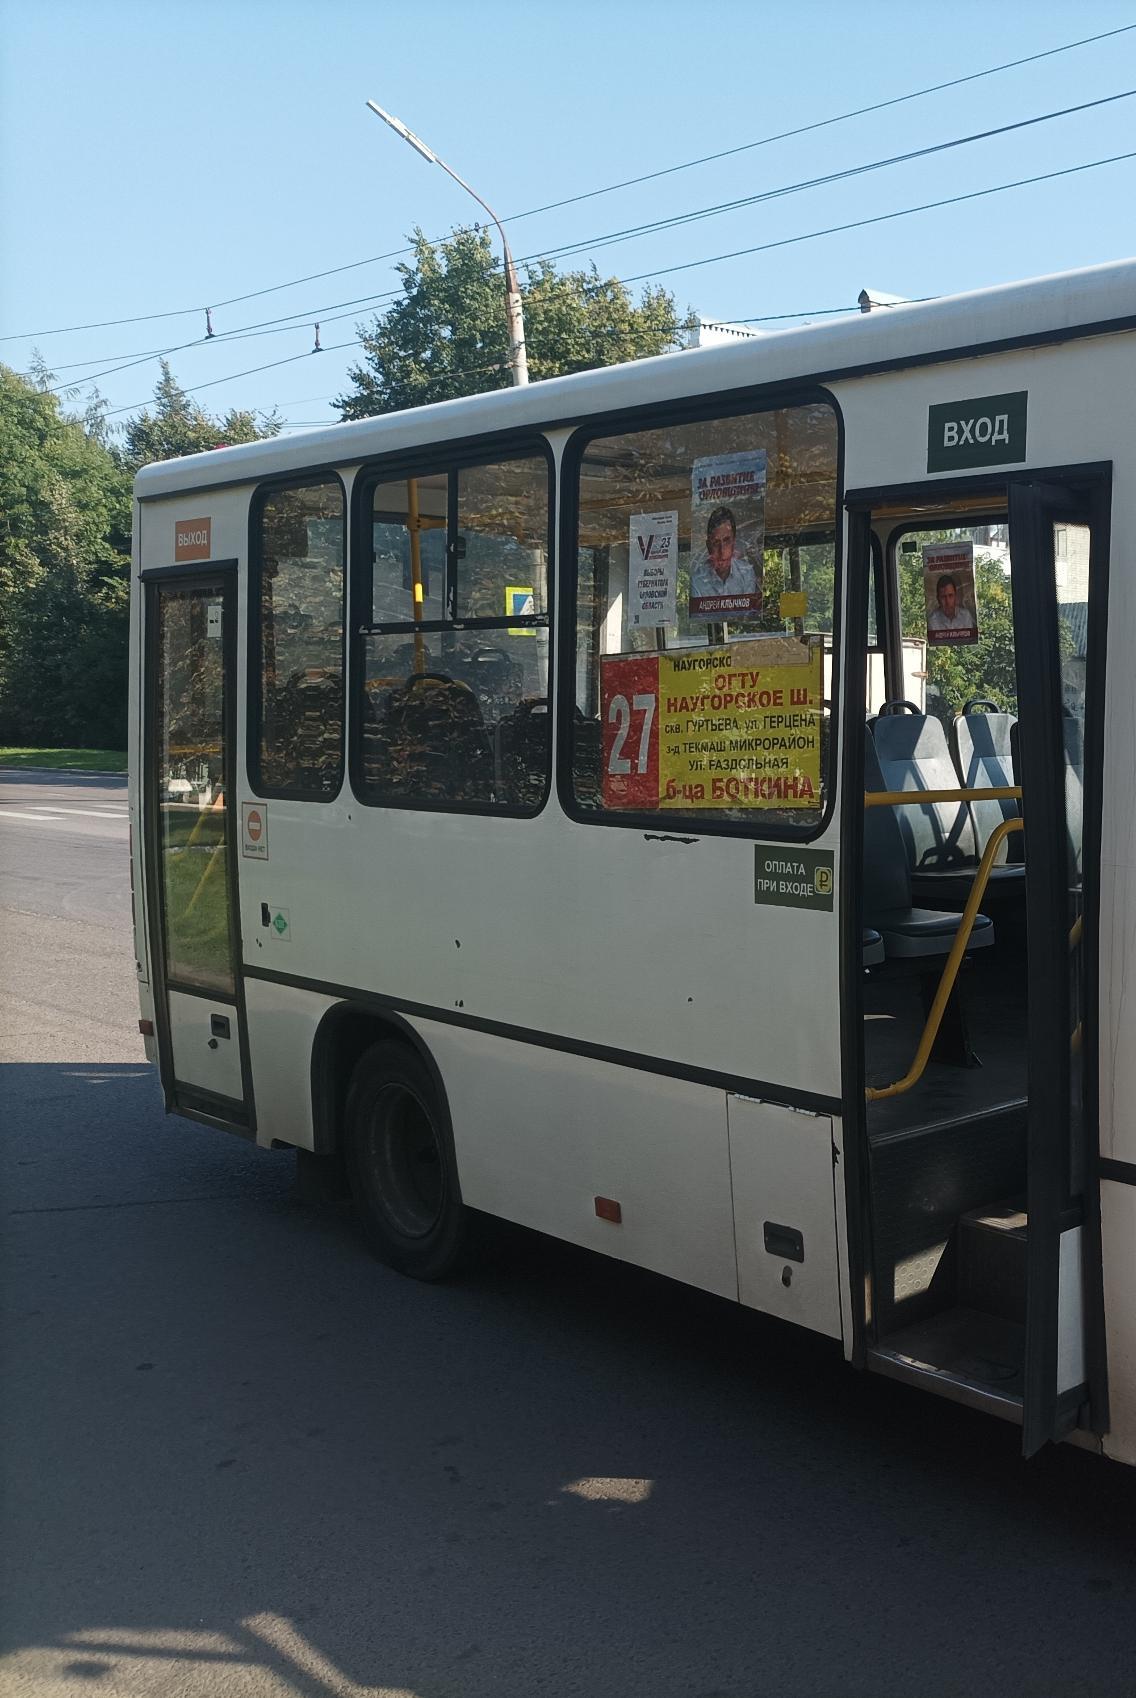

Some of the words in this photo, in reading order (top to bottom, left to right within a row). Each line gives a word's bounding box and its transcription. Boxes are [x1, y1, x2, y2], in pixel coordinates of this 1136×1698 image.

[943, 414, 1009, 447] ВХОД
[178, 530, 208, 547] ВЫХОД
[714, 671, 760, 691] ОГТУ
[666, 689, 784, 714] НАУГОРСКОЕ
[790, 688, 814, 706] Ш.
[763, 713, 816, 731] ГЕРЦЕНА
[608, 693, 656, 775] 27
[683, 740, 726, 754] ТЕКМАШ
[729, 734, 815, 752] МИКРОРАЙОН
[688, 760, 705, 772] УЛ.
[708, 757, 789, 772] РАЗДОЛЬНАЯ
[666, 778, 705, 802] б-ца
[711, 775, 815, 801] БОТКИНА
[764, 860, 806, 876] ОПЛАТА
[757, 879, 777, 892] ПРИ
[779, 881, 814, 898] ВХОДЕ
